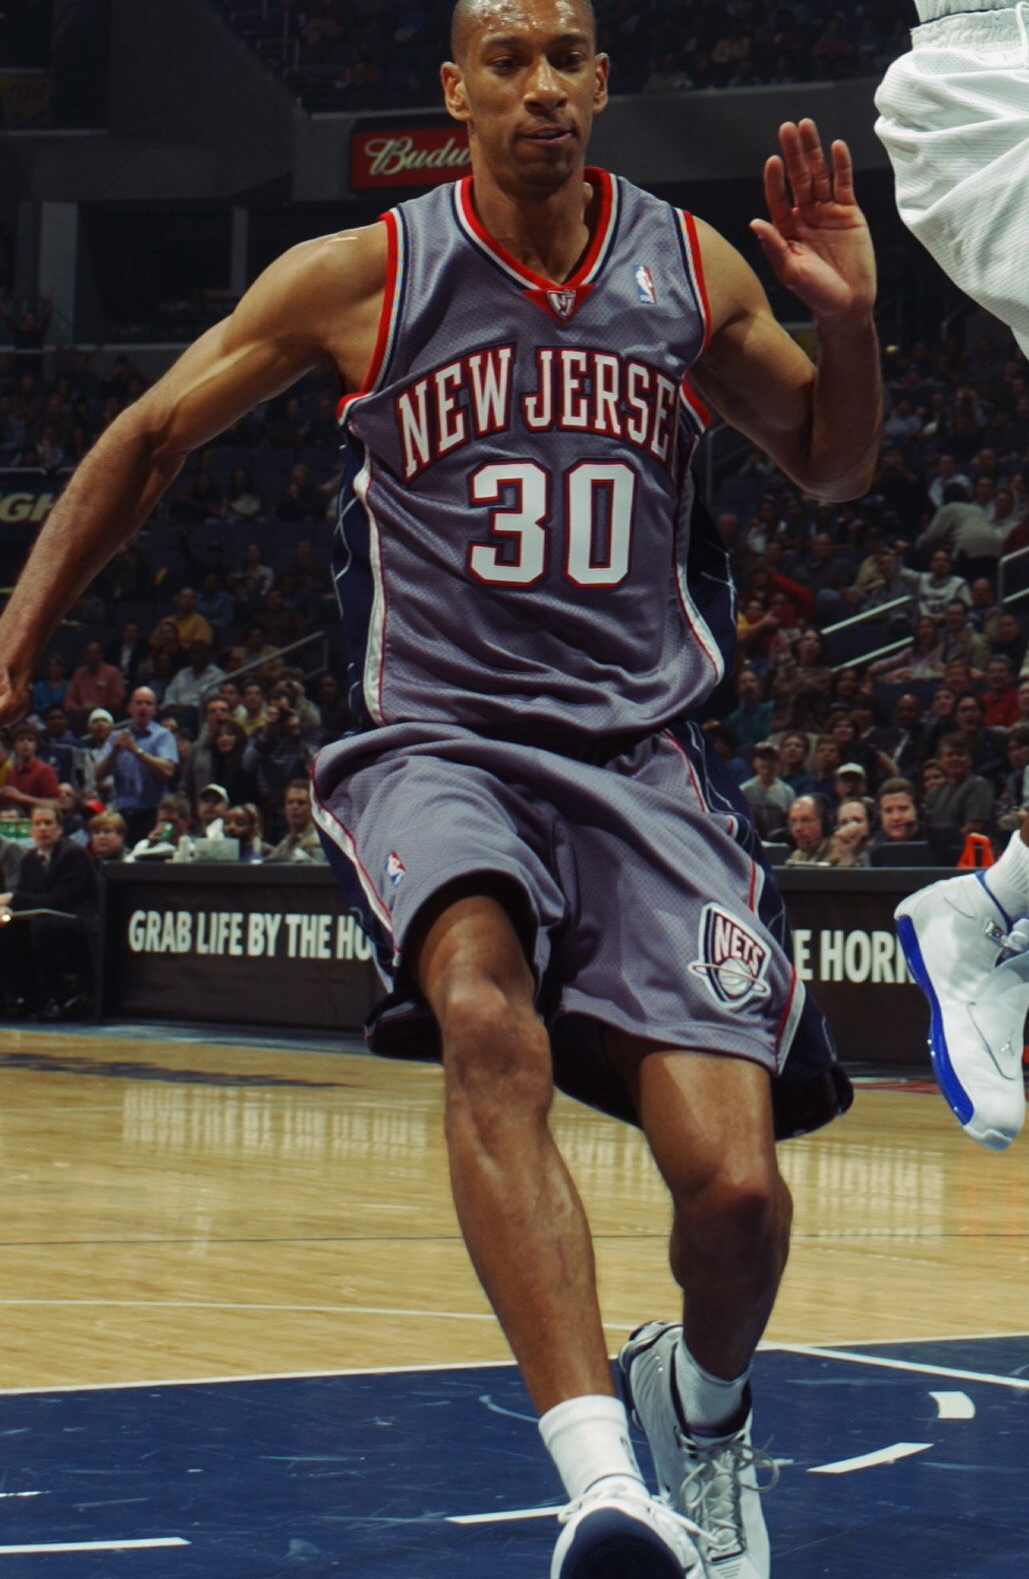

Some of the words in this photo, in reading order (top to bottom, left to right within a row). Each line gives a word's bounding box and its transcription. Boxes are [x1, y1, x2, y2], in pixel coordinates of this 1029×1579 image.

[394, 342, 517, 486] NEW
[521, 345, 678, 470] JERSE
[468, 458, 638, 588] 30
[128, 910, 192, 953] GRAB
[196, 912, 243, 956] LIFE
[247, 913, 282, 957] BY
[285, 914, 333, 958] THE
[714, 914, 764, 978] NETS
